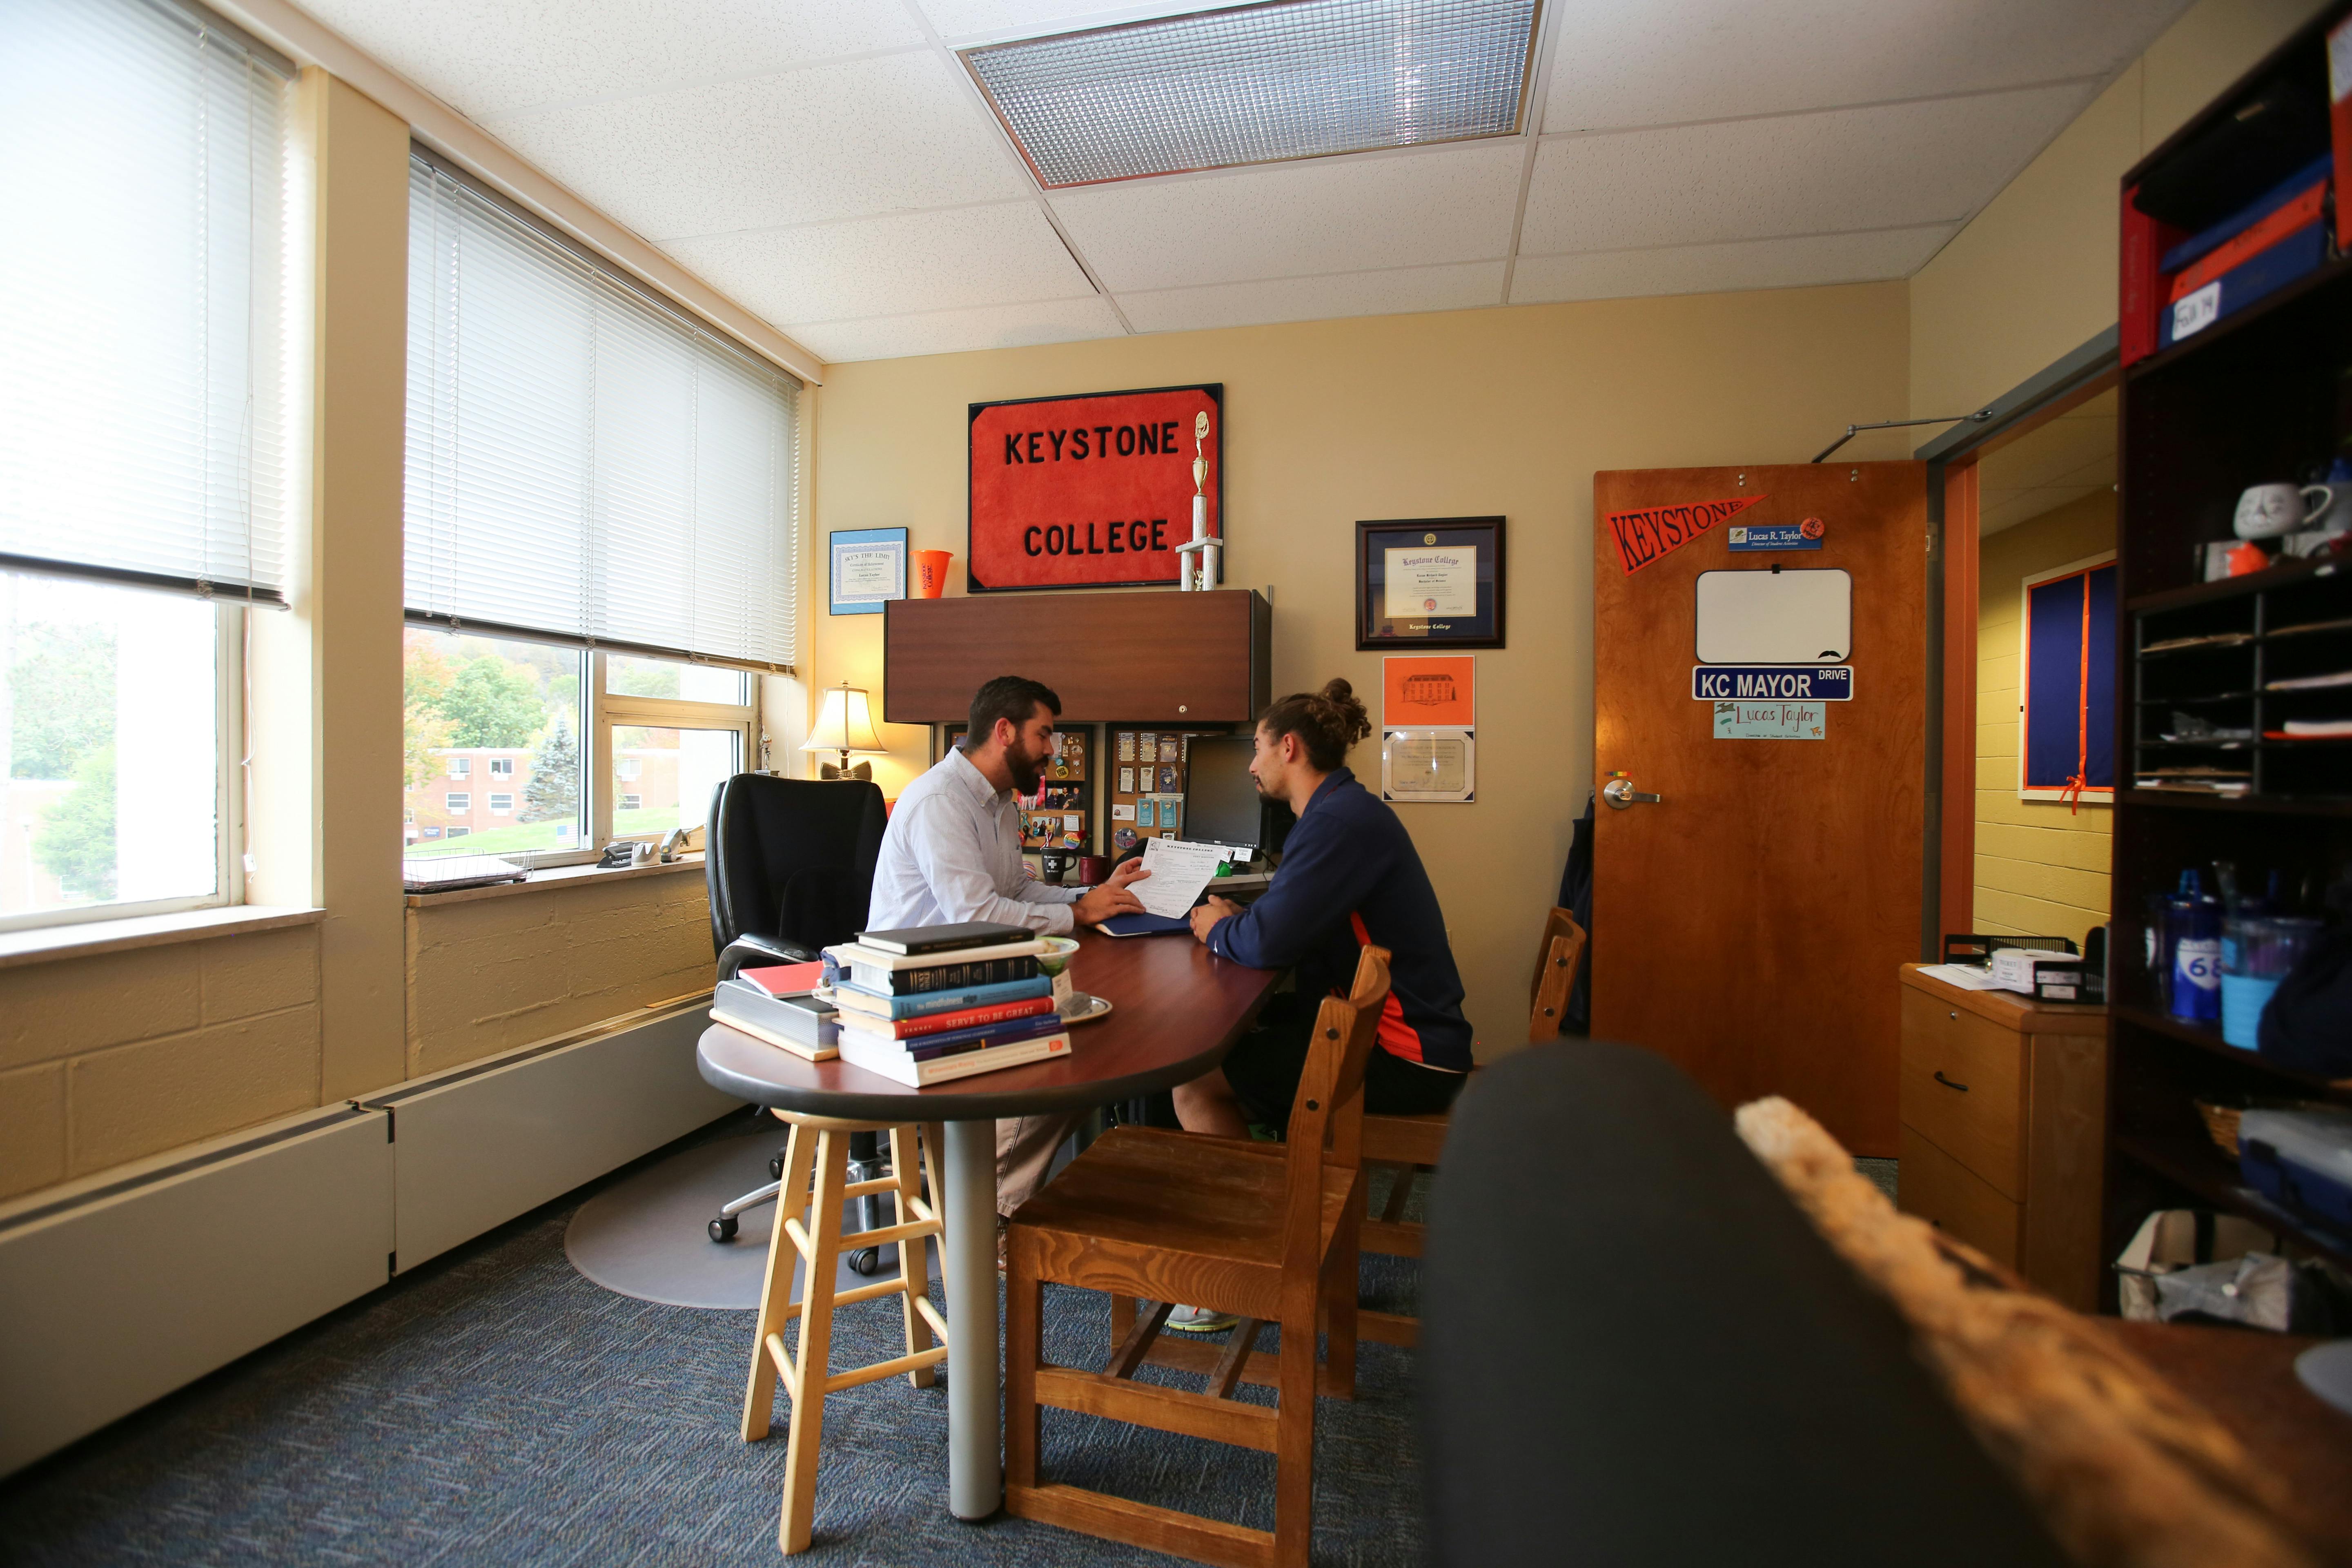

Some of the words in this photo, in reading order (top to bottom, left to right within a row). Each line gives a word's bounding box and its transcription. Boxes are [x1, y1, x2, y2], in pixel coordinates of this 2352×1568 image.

[1005, 422, 1179, 465] KEYSTONE
[1024, 520, 1168, 557] COLLEGE
[1611, 501, 1744, 572] KEYSTONE
[1748, 532, 1768, 540] Lucas
[1770, 532, 1778, 540] R.
[1780, 531, 1802, 541] Taylor
[845, 554, 858, 562] SKY'S
[1402, 557, 1433, 566] Keystone
[1434, 556, 1459, 566] College
[1702, 675, 1730, 697] KC
[1737, 675, 1812, 697] MAYOR
[1819, 670, 1846, 680] DRIVE
[1737, 706, 1775, 724] Lucas
[1776, 704, 1818, 732] Taylor
[925, 997, 963, 1009] mindfulness
[946, 1017, 974, 1028] SERVE
[1006, 1007, 1033, 1018] GREAT
